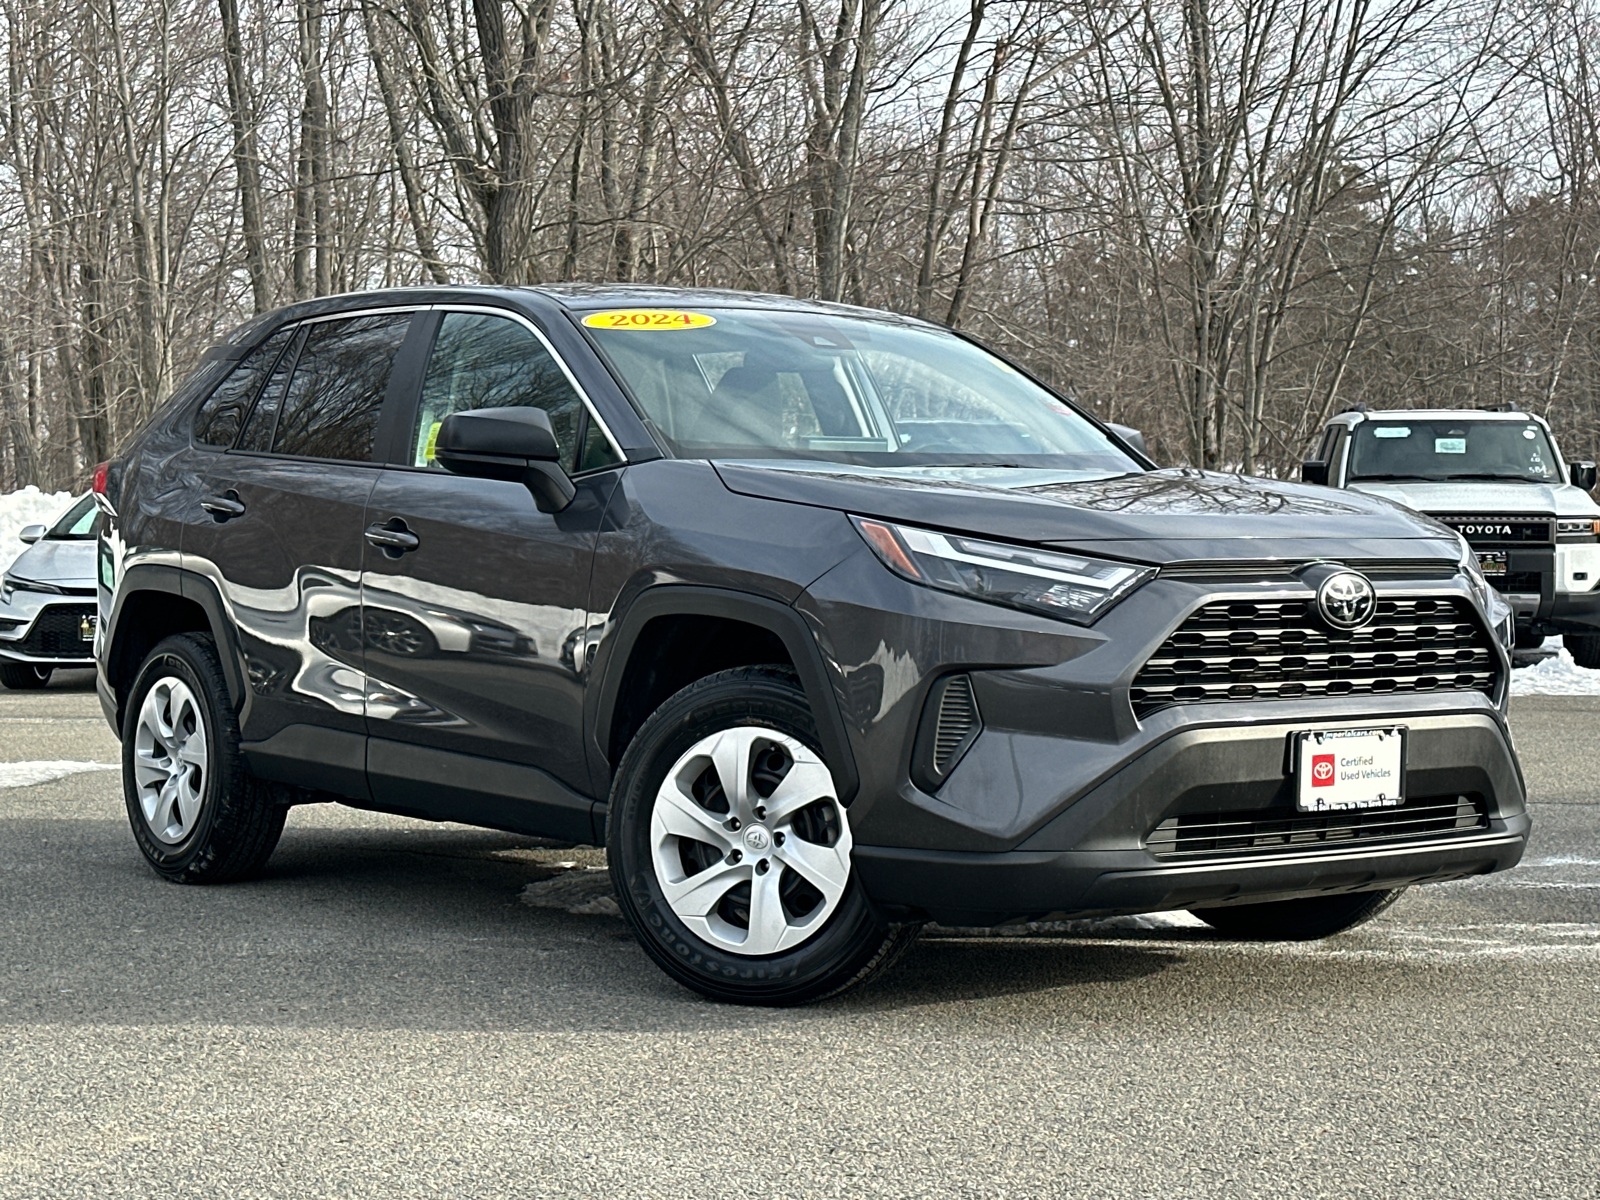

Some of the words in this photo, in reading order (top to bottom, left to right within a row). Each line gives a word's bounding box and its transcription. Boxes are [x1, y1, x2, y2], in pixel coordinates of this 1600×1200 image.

[609, 313, 695, 327] 2024
[1457, 525, 1512, 535] TOYOTA
[693, 700, 811, 728] DESTINA
[1340, 756, 1374, 767] Certified
[1340, 771, 1360, 780] Used
[1361, 768, 1391, 779] Vehicles
